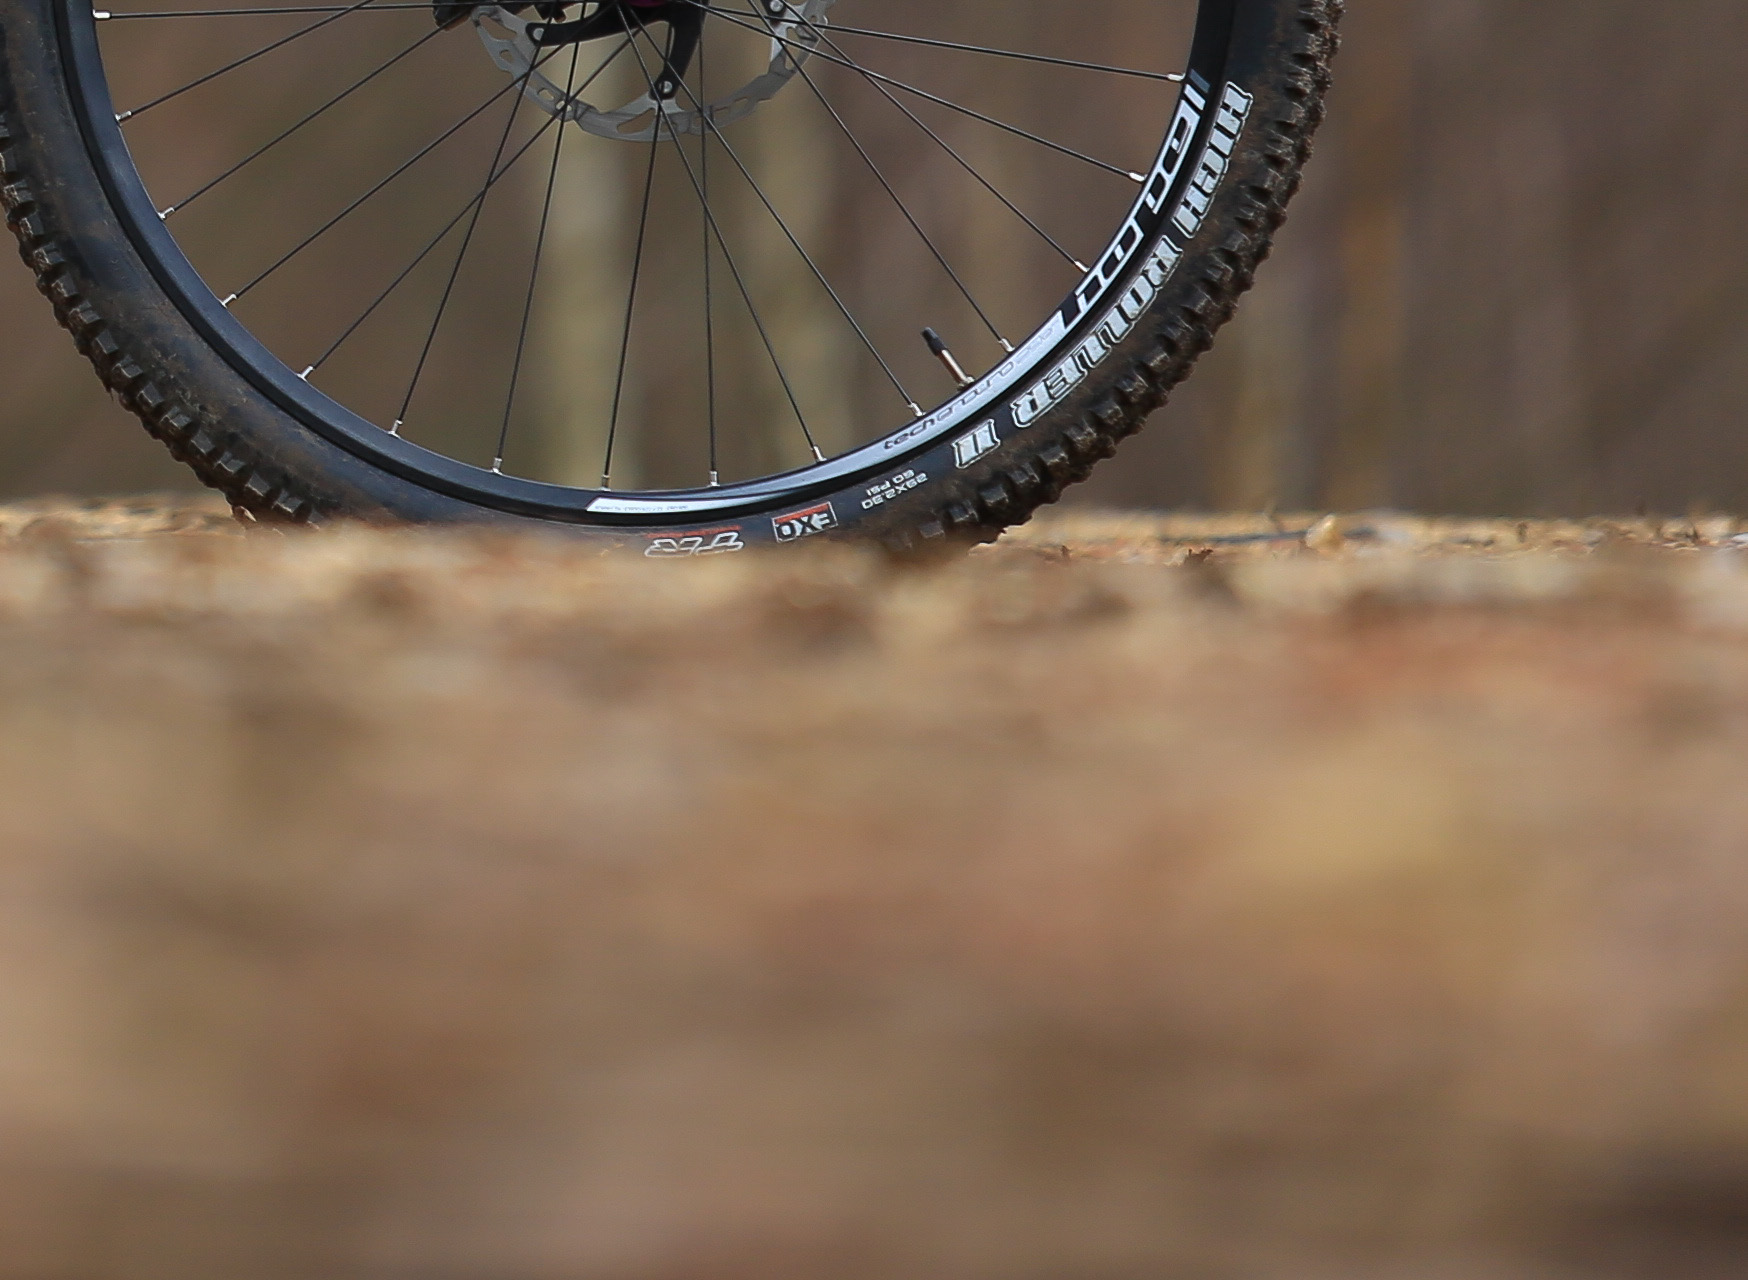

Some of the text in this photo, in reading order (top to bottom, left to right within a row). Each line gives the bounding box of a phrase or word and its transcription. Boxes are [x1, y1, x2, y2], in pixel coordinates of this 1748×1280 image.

[1171, 81, 1253, 239] HIGH
[1010, 235, 1184, 429] ROLLER
[883, 417, 936, 450] tech
[865, 479, 891, 497] PSI
[774, 511, 831, 542] EXO
